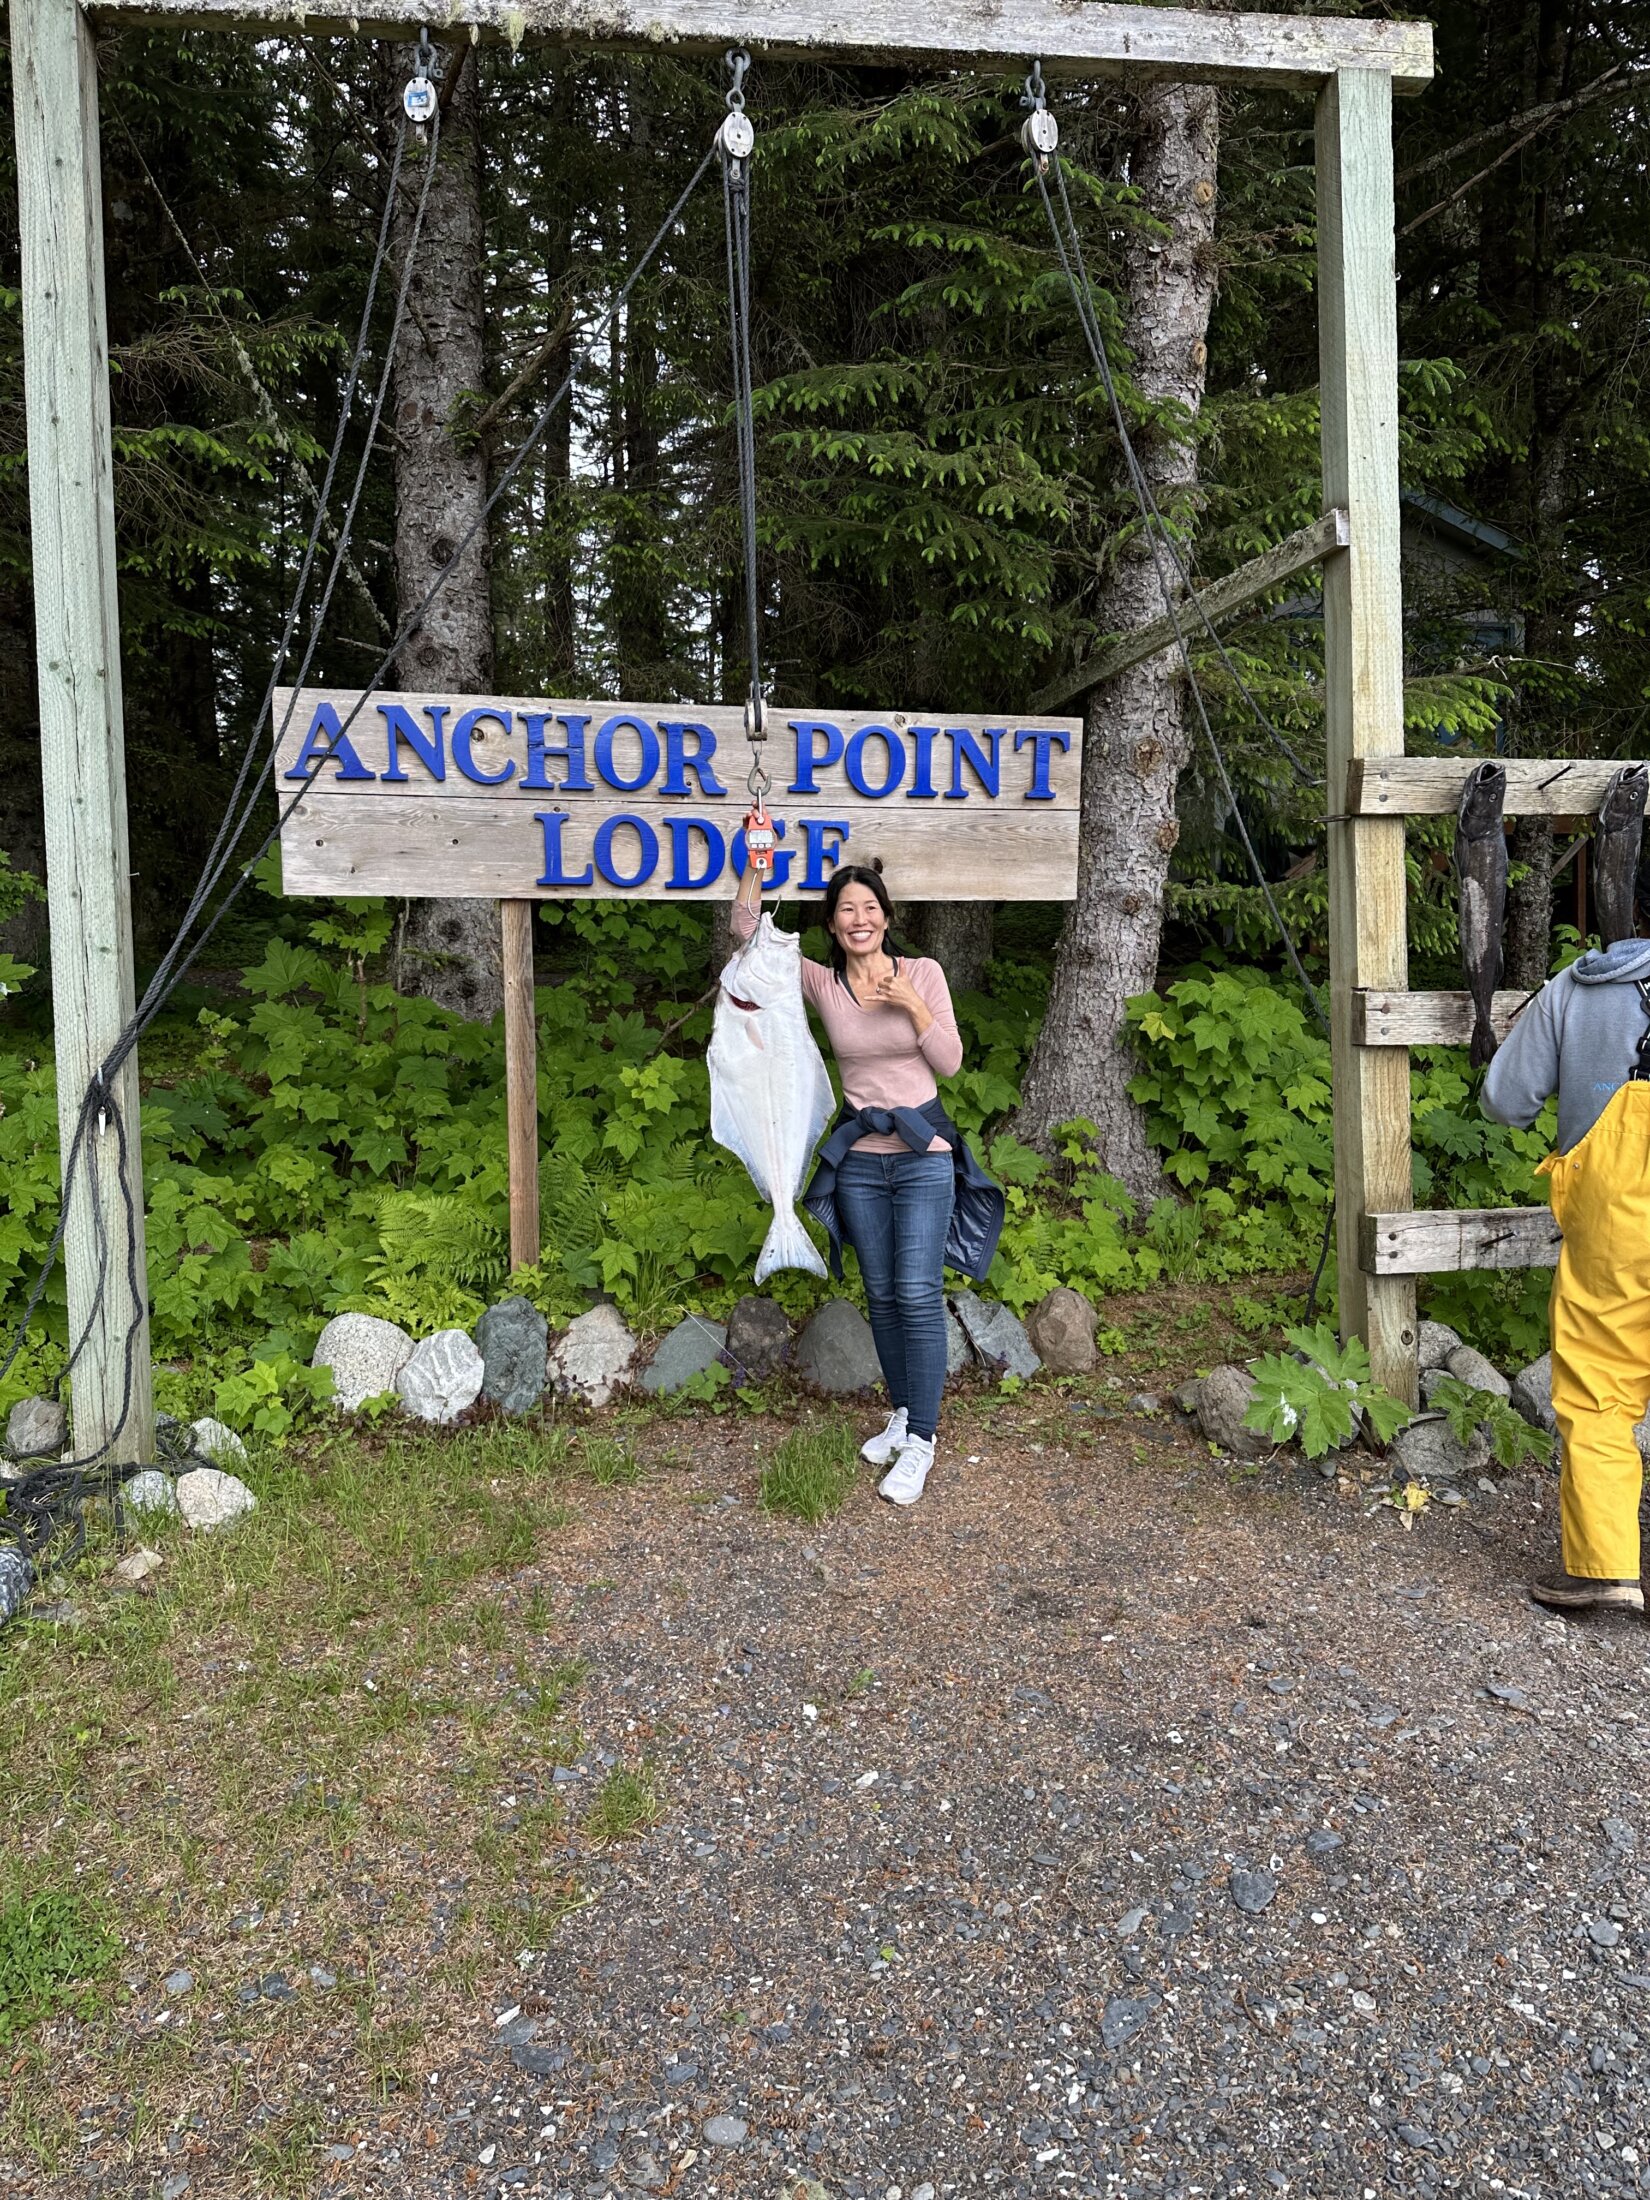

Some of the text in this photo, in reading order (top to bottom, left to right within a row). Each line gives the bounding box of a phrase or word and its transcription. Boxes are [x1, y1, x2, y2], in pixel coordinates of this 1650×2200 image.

[284, 702, 1070, 798] ANCHOR POINT
[536, 813, 849, 889] LODGE
[1593, 1081, 1622, 1091] ANC
